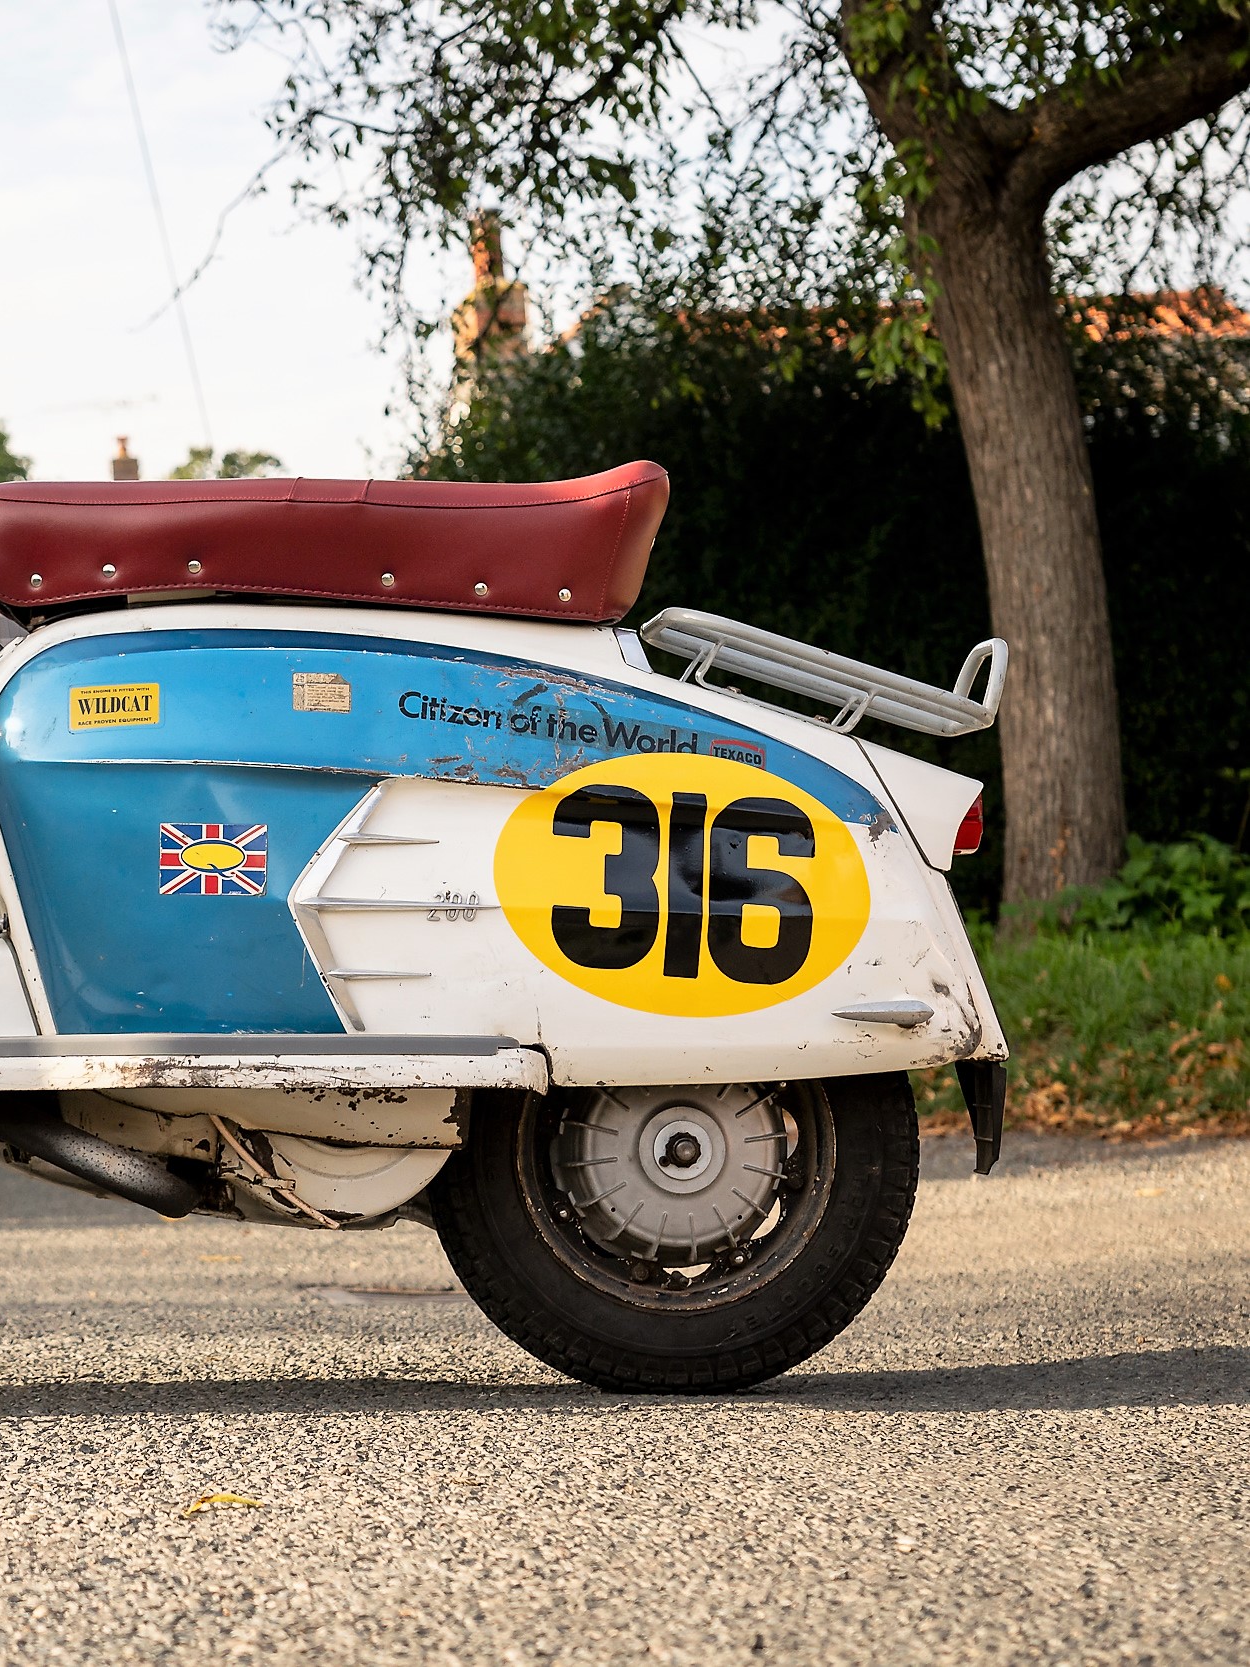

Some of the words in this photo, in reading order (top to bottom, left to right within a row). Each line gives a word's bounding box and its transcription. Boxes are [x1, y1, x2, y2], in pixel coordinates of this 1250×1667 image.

[78, 695, 153, 715] WILDCAT
[510, 705, 543, 736] of
[546, 708, 598, 744] the
[603, 717, 699, 754] World
[713, 746, 762, 765] TEXACO
[551, 784, 816, 985] 316
[427, 892, 480, 922] 200
